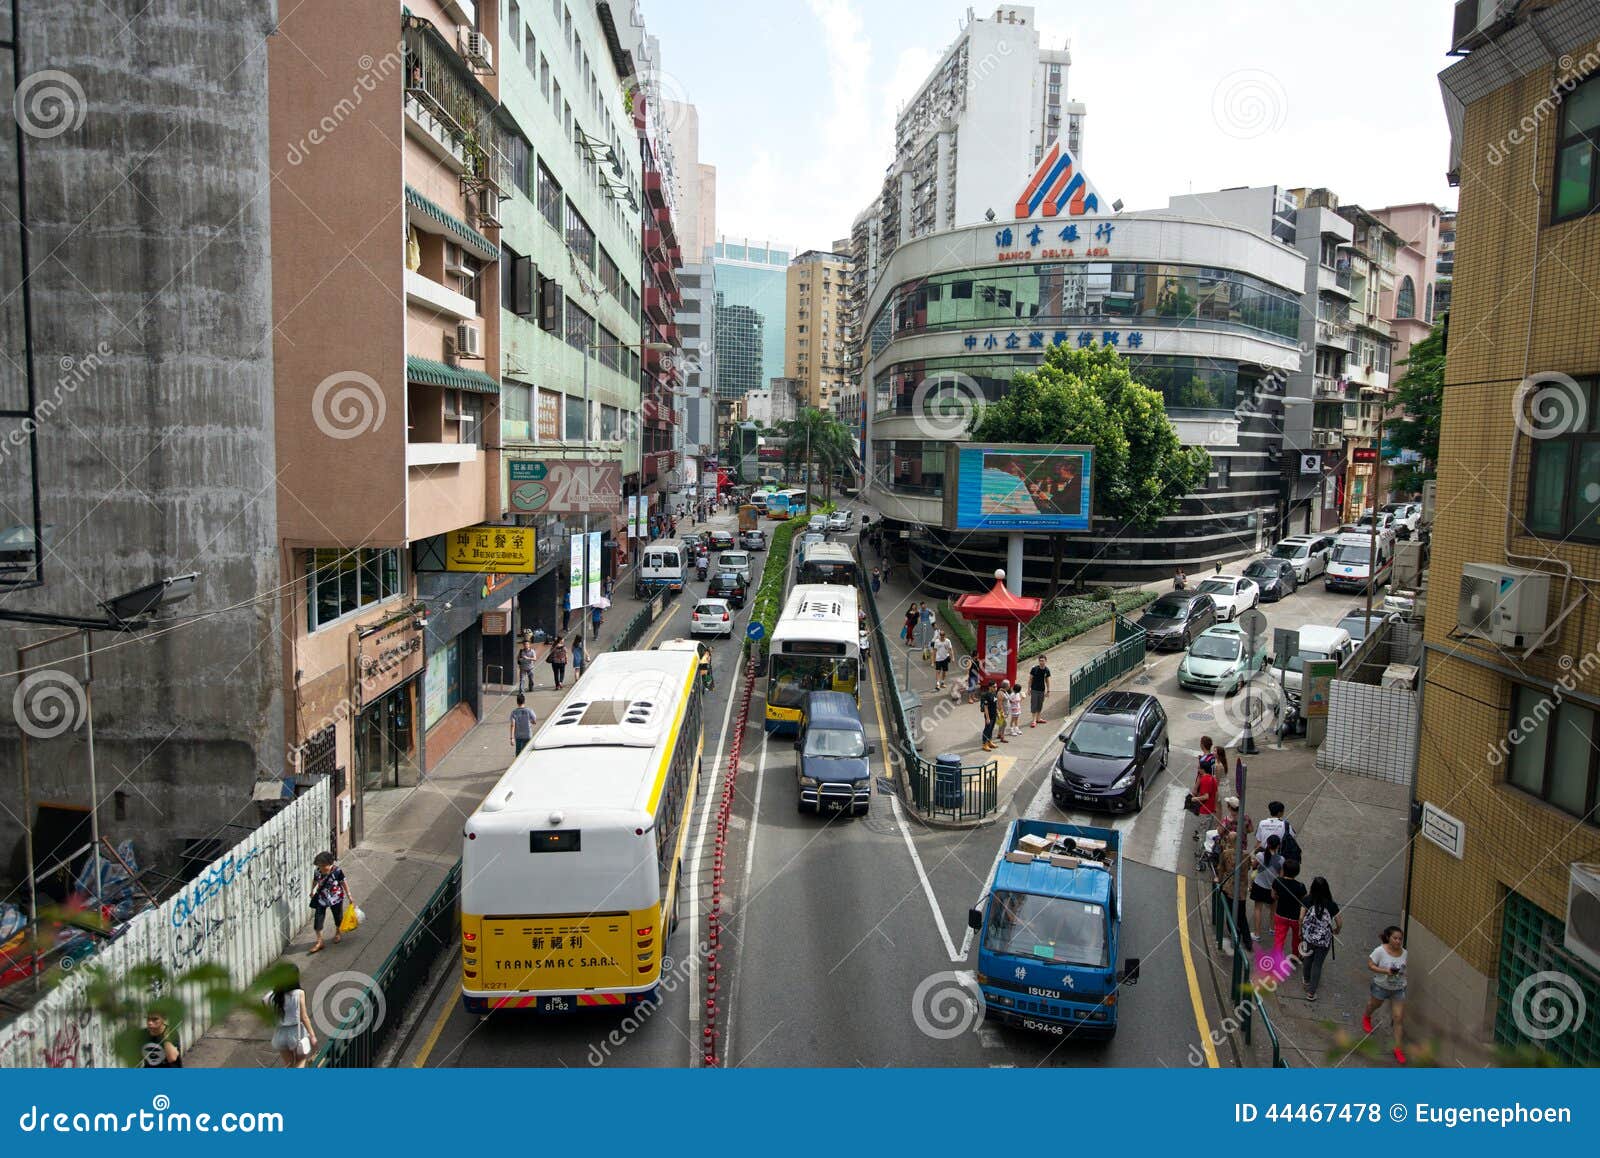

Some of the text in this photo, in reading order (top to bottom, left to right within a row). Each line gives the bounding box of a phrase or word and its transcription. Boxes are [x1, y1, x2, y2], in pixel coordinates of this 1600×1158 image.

[998, 247, 1110, 261] BANCO DELTA ASIA
[531, 935, 583, 950] 新福利
[495, 956, 619, 970] TRANSMAC S.A.R.L.
[1028, 986, 1061, 999] ISUZU
